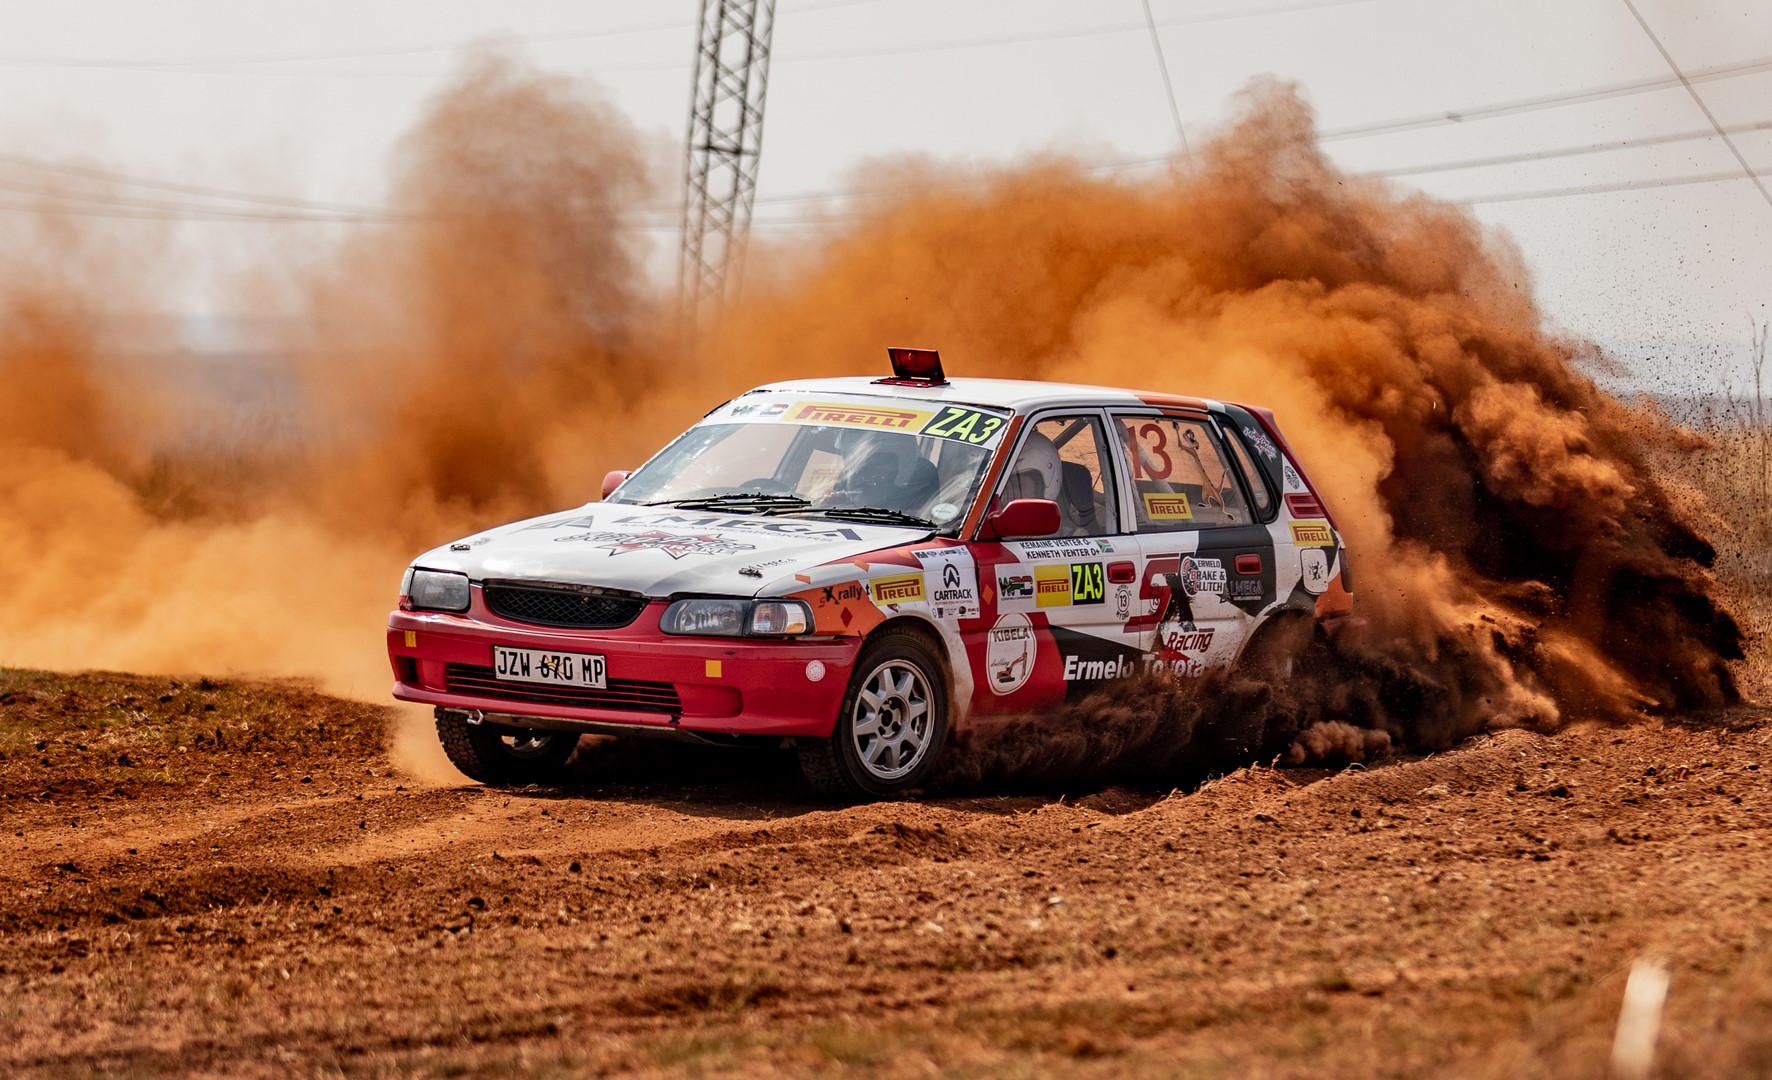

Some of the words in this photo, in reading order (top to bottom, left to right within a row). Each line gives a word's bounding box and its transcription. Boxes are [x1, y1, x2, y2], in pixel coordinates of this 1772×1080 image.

[796, 405, 917, 428] PIRELLI
[923, 407, 1002, 443] ZA3
[1127, 424, 1172, 479] 13
[1148, 498, 1187, 515] PIRELLI
[1293, 526, 1329, 541] PIRELLI
[1020, 540, 1053, 549] KEMAINE
[1053, 538, 1083, 547] VENTER
[1026, 549, 1059, 559] KENNETH
[1062, 548, 1090, 557] VENTER
[1198, 560, 1220, 568] ERMELO
[1072, 563, 1103, 600] ZA3
[1191, 571, 1217, 580] BRAKE
[1219, 571, 1226, 580] &
[838, 585, 862, 601] rally
[875, 579, 921, 601] PIRELLI
[1037, 578, 1069, 593] PIRELLI
[1194, 581, 1222, 592] CLUTCH
[934, 589, 973, 601] CARTRACK
[1120, 594, 1127, 607] 13
[993, 628, 1030, 642] KIBELA
[1166, 629, 1214, 653] Racing
[498, 651, 530, 677] JZW
[540, 655, 574, 680] 670
[581, 658, 603, 683] MP
[1063, 654, 1135, 681] Ermelo
[1141, 653, 1205, 679] Toota
